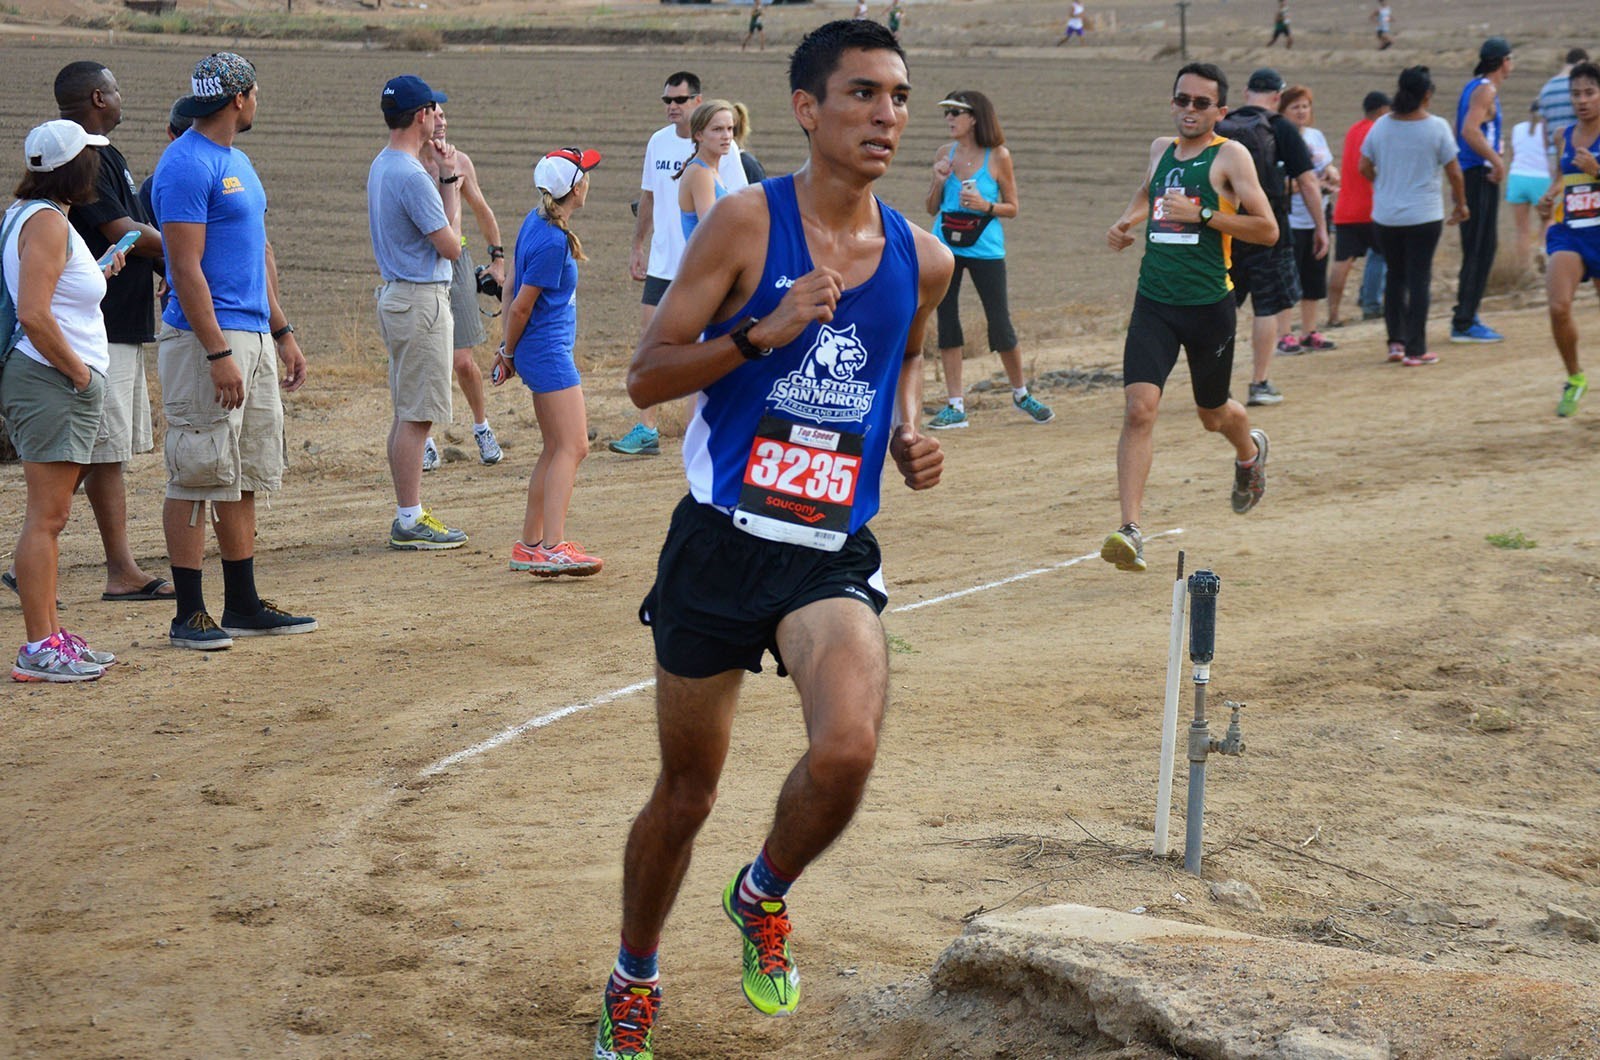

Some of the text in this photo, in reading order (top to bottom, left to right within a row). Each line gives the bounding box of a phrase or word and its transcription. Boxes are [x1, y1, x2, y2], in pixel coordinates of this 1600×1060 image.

[655, 160, 671, 170] CAL
[791, 374, 866, 395] CAL STATE
[773, 382, 872, 411] SAN MARCOS
[787, 401, 859, 418] TRACK AND FIELD
[750, 441, 857, 503] 3235
[765, 495, 816, 516] saucony
